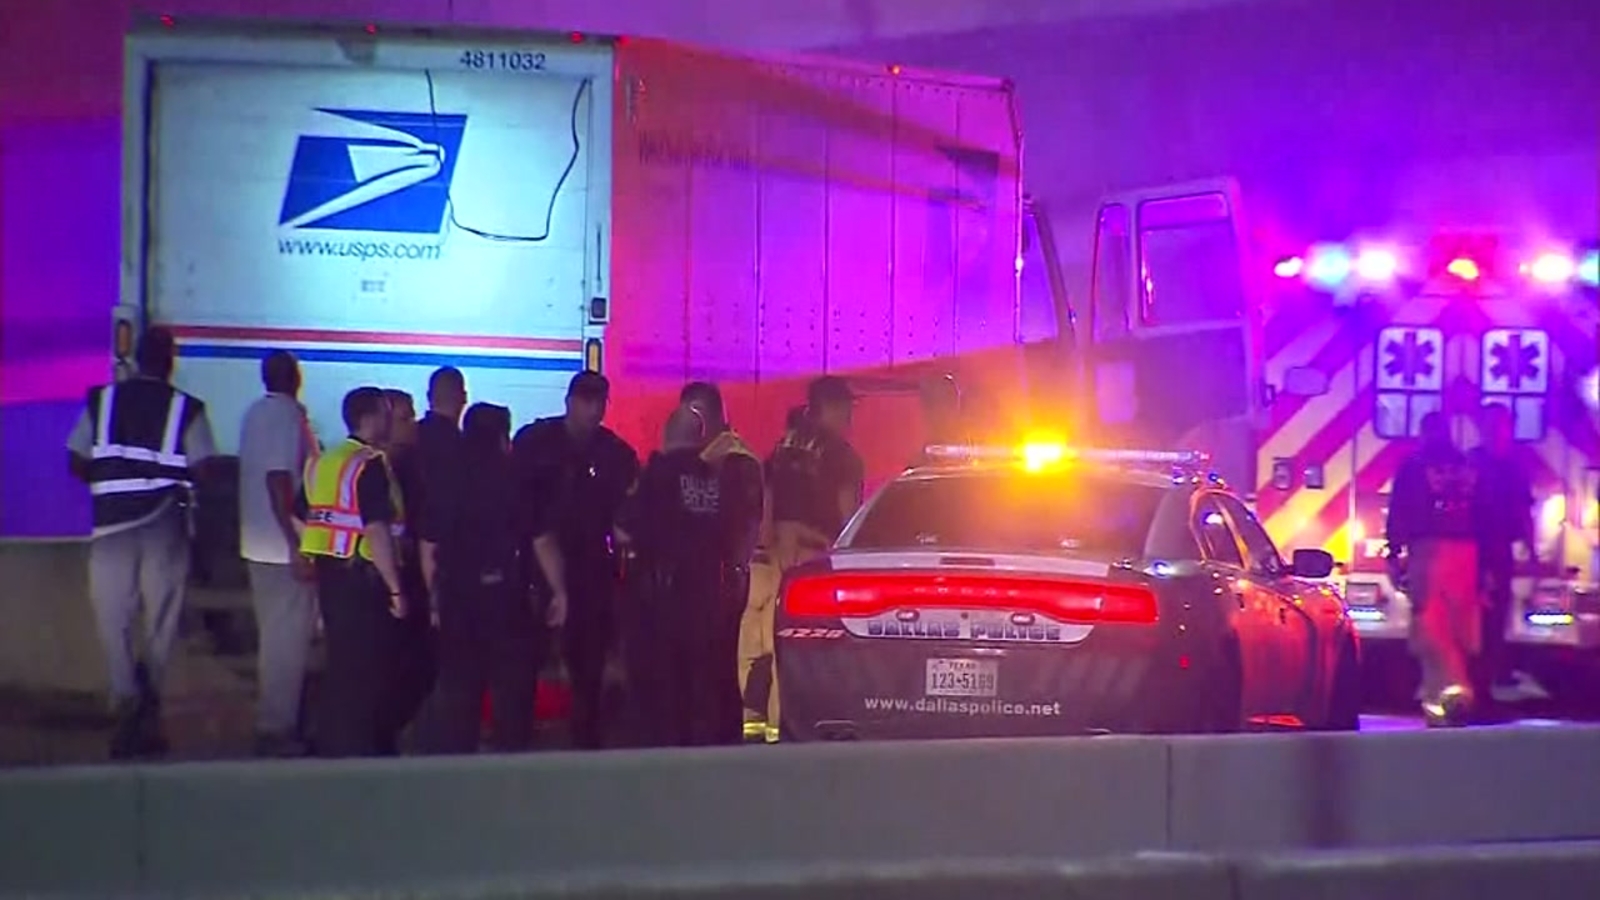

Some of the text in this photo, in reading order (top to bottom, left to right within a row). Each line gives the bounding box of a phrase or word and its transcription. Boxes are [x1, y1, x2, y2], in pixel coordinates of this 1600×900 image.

[459, 50, 547, 71] 4811032
[278, 239, 441, 262] www.usps.com
[868, 620, 1061, 641] DALLAS POLICE
[864, 698, 1061, 716] www.dallaspolice.net
